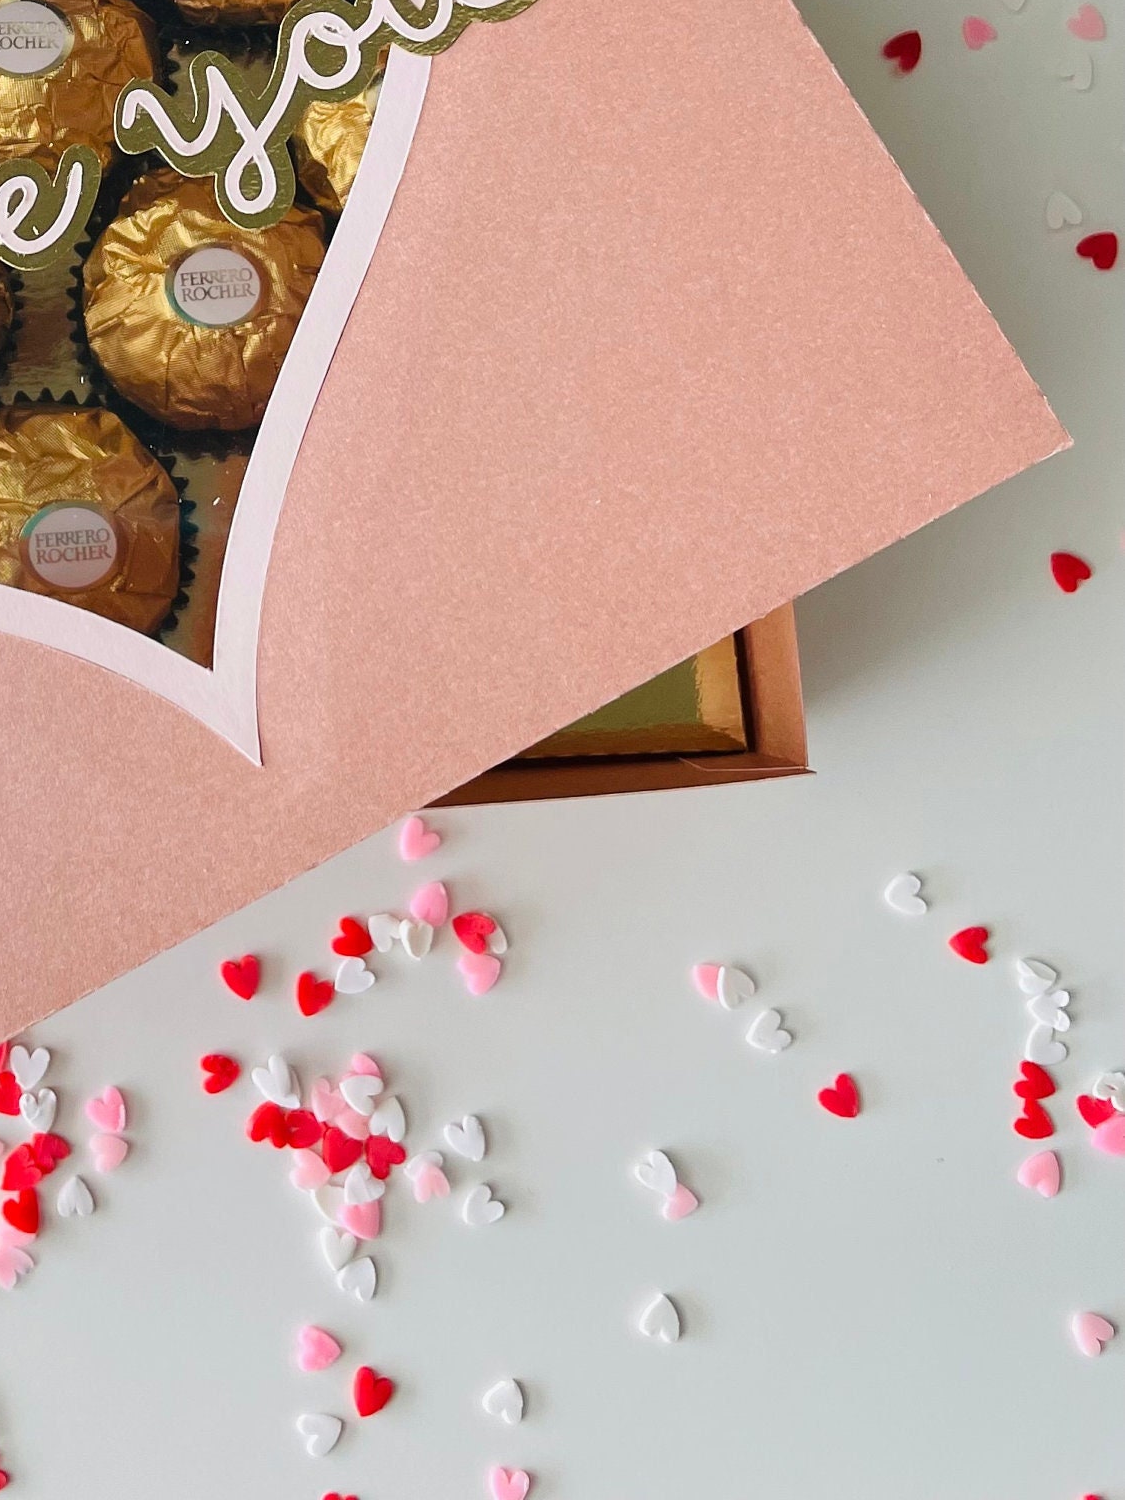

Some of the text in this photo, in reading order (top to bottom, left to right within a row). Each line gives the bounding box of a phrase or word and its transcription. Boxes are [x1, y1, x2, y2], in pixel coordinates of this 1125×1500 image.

[179, 267, 253, 287] FERRERO
[180, 283, 257, 303] ROCHER
[35, 527, 110, 548] FERRERO
[35, 543, 112, 565] ROCHER
